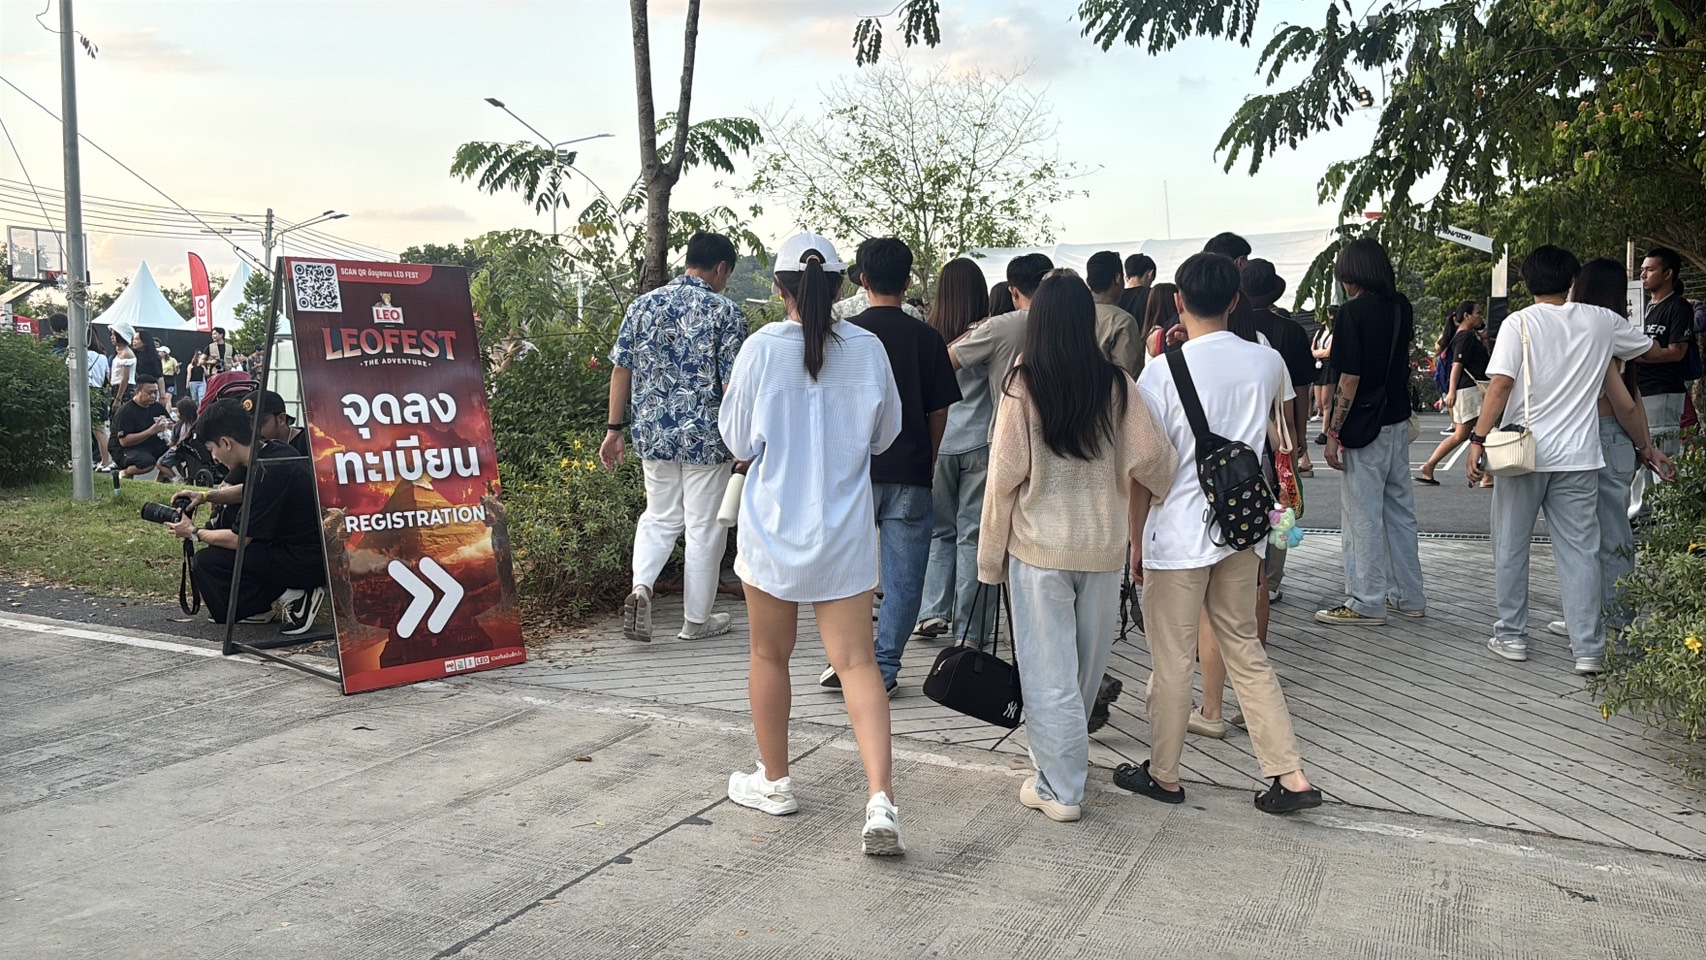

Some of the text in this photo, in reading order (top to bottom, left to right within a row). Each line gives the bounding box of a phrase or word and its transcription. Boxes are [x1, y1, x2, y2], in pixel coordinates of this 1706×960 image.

[340, 267, 357, 276] SCAN
[358, 268, 367, 277] QR
[393, 270, 404, 278] LEO
[405, 271, 419, 279] FEST
[196, 298, 206, 326] LEO
[375, 309, 400, 320] LEO
[322, 328, 457, 360] LEOFEST
[364, 358, 428, 368] THE ADVENTURE
[340, 392, 457, 440] จุดลง
[334, 435, 481, 485] ทะเบียน
[344, 505, 487, 533] REGISTRATION
